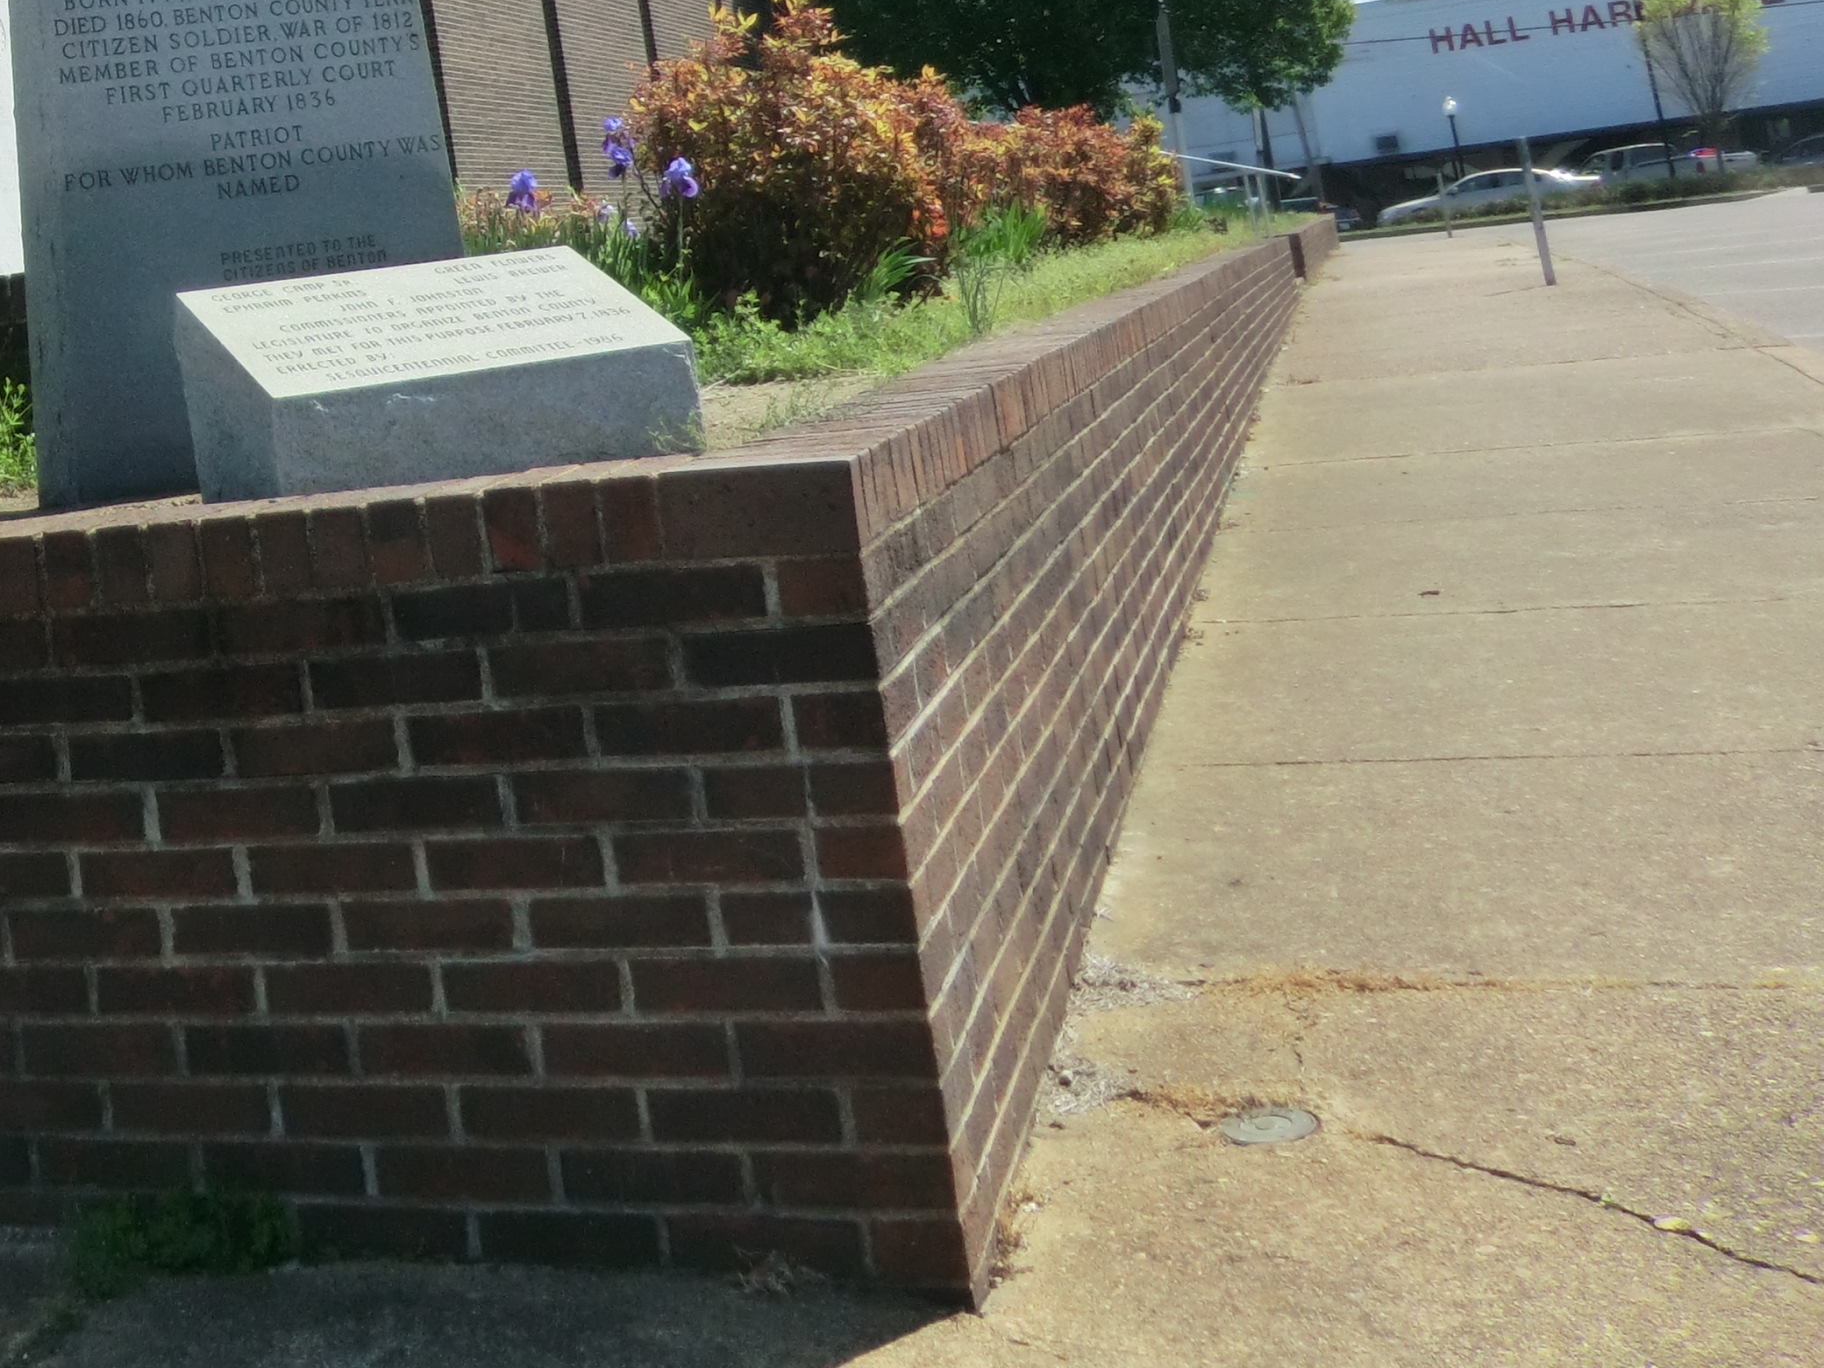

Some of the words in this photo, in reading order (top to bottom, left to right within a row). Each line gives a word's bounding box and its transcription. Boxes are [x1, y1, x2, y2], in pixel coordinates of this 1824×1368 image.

[54, 16, 107, 36] DIED
[173, 2, 259, 26] BENTON
[62, 34, 159, 59] CITIZEN
[280, 19, 327, 40] WAR
[336, 16, 363, 33] OF
[373, 11, 413, 31] 1812
[1427, 16, 1530, 54] HALL
[58, 59, 159, 84] MEMBER
[170, 55, 198, 74] OF
[211, 45, 304, 70] BENTON
[314, 33, 420, 60] COUNTY'S
[105, 82, 171, 105] FIRST
[182, 68, 312, 97] QUARTERLY
[322, 60, 396, 82] COURT
[162, 95, 277, 123] FEBRUARY
[287, 88, 336, 112] 1836
[210, 125, 303, 151] PATRIOT
[64, 170, 112, 192] FOR
[120, 161, 194, 185] WHOM
[203, 150, 292, 177] BENTON
[301, 139, 391, 166] COUNTY
[397, 134, 441, 155] WAS
[217, 174, 300, 200] NAMED
[220, 242, 316, 265] PRESENTED
[322, 238, 341, 253] TO
[348, 235, 376, 249] THE
[223, 261, 296, 282] CITIZENS
[301, 258, 320, 272] OF
[326, 249, 388, 270] BENTON
[434, 262, 482, 275] GREEN
[491, 253, 557, 267] FLOWERS
[211, 289, 273, 302] GEORGE
[281, 280, 325, 293] CAMP
[452, 272, 499, 285] LEWIS
[509, 264, 569, 278] BREWER
[223, 298, 293, 314] EPHRAIM
[303, 290, 367, 304] PERKINS
[279, 310, 407, 333] COMMISSIONERS
[416, 299, 497, 316] APPOINTED
[506, 293, 527, 303] BY
[535, 288, 565, 299] THE
[339, 301, 379, 313] JOHN
[410, 287, 484, 303] JOHNSTON
[252, 331, 353, 350] LEGISLATURE
[365, 325, 384, 336] TO
[391, 315, 466, 331] ORGANIZE
[473, 306, 532, 321] BENTON
[538, 296, 597, 312] COUNTY
[263, 350, 304, 364] THEY
[312, 345, 344, 357] MET
[352, 339, 382, 351] FOR
[388, 333, 423, 346] THIS
[426, 324, 495, 341] PURPOSE
[497, 313, 574, 333] FEBRUARY
[276, 357, 357, 376] ERRECTED
[326, 353, 480, 381] SESQUICENTENNIAL
